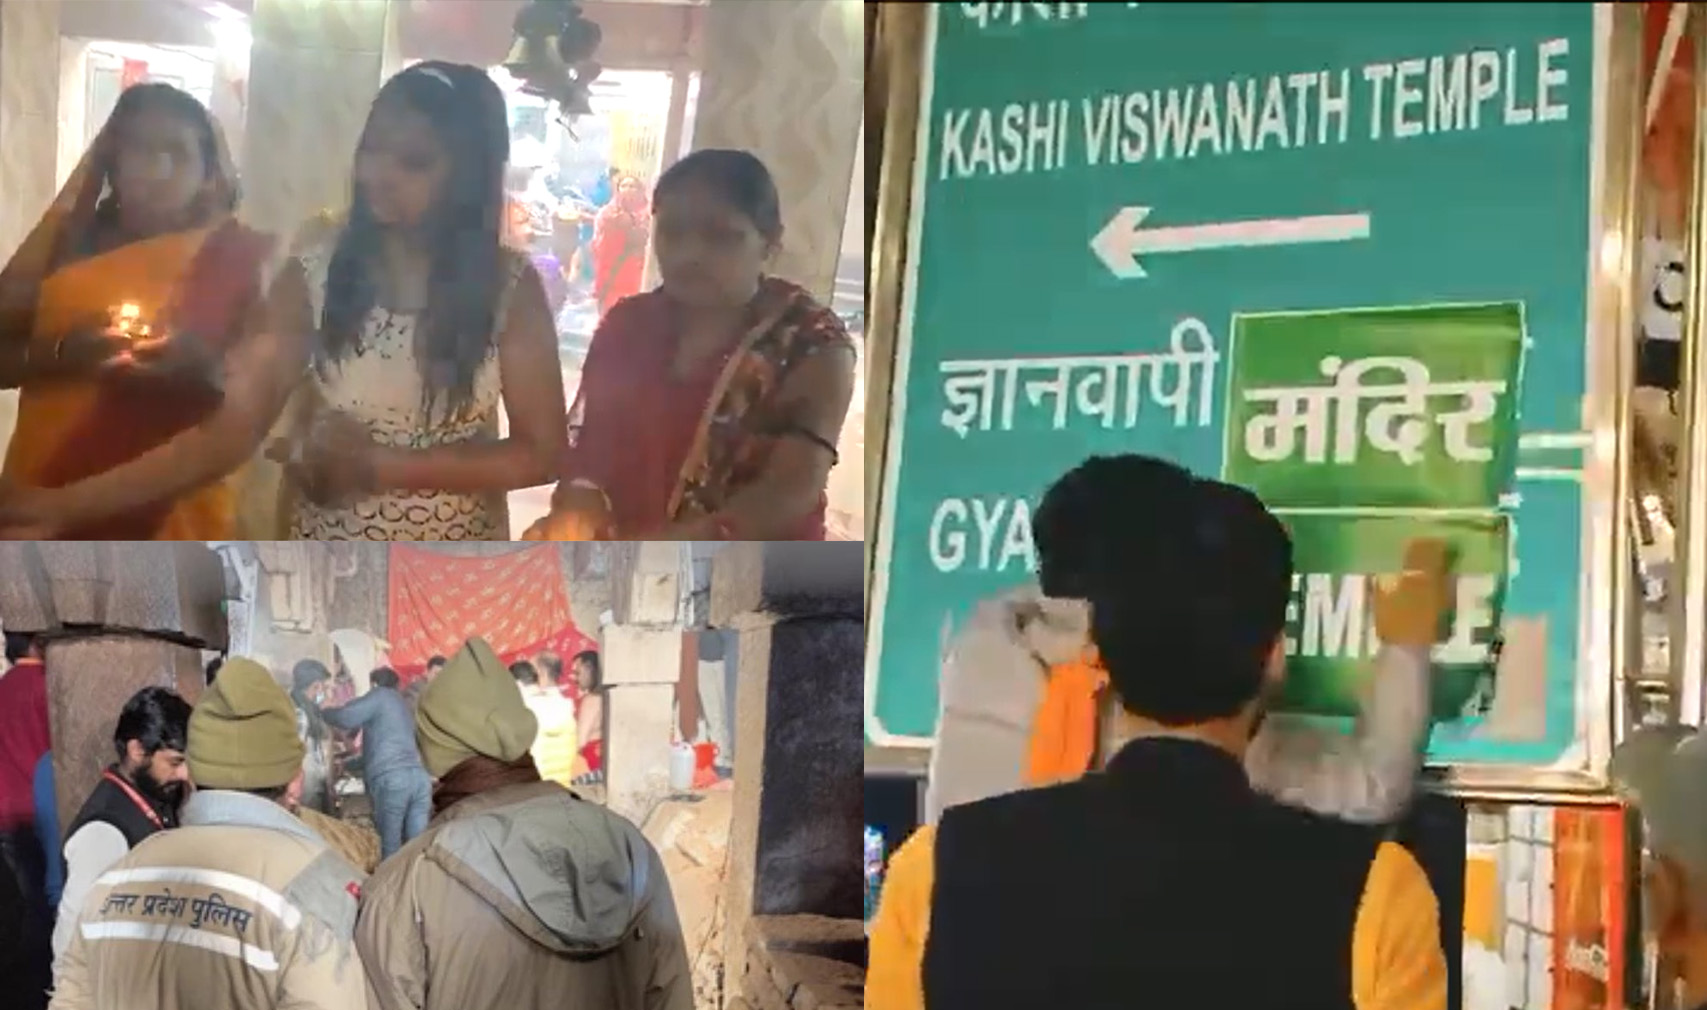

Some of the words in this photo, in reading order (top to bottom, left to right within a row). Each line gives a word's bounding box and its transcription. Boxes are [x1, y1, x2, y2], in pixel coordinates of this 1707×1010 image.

[939, 98, 1069, 180] KASHI
[1081, 67, 1350, 167] VISWANATH
[1363, 37, 1570, 140] TEMPLE
[939, 317, 1220, 439] ज्ञानवापी
[1243, 355, 1507, 465] मंदिर
[1284, 571, 1496, 664] EME
[142, 887, 188, 918] प्रदेश
[190, 892, 254, 933] पुलिस
